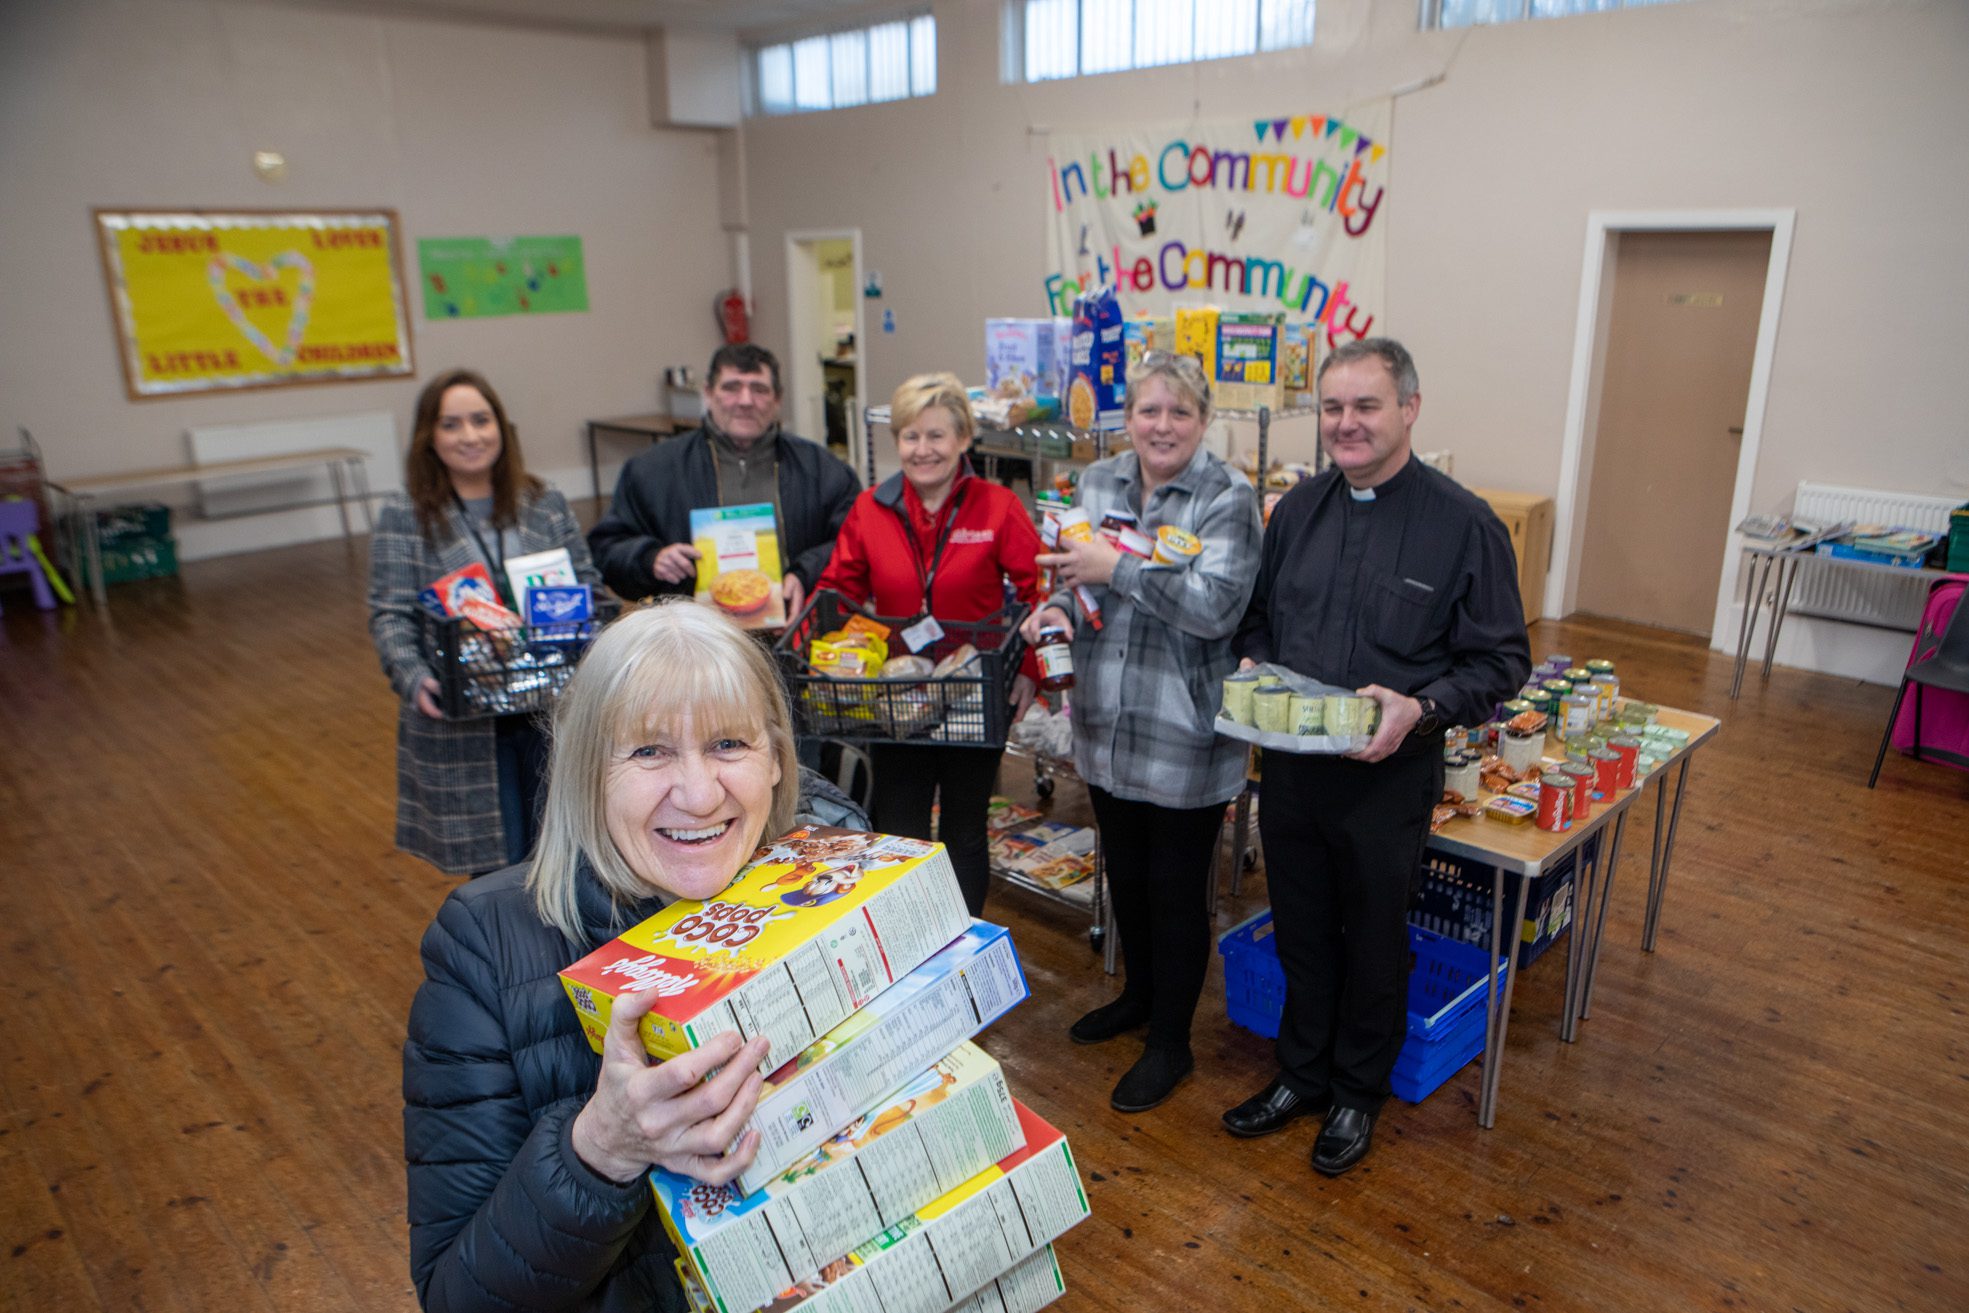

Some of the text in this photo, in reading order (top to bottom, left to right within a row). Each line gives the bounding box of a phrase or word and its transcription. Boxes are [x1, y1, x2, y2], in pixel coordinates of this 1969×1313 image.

[1048, 140, 1385, 238] In the Community
[1159, 240, 1375, 351] Community
[703, 902, 777, 924] pops
